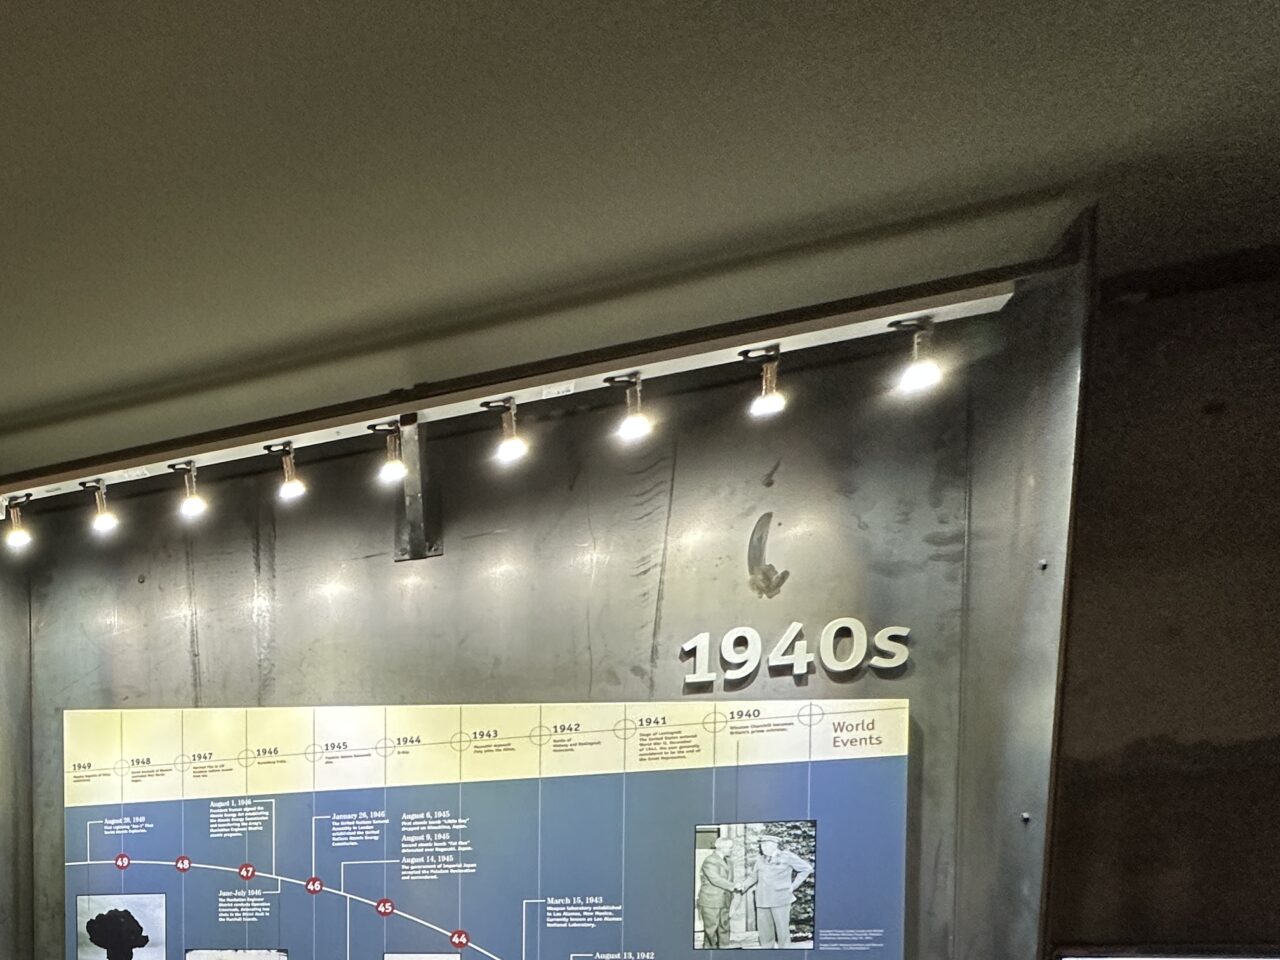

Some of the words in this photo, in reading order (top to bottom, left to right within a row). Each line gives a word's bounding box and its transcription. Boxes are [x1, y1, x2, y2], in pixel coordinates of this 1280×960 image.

[681, 617, 911, 684] 1940s
[730, 709, 760, 719] 1940
[639, 716, 666, 726] 1941
[553, 724, 580, 733] 1942
[832, 720, 875, 733] World
[473, 730, 498, 739] 1943
[396, 736, 421, 745] 1944
[832, 735, 882, 748] Events
[325, 742, 348, 751] 1945
[257, 747, 279, 756] 1946
[192, 753, 213, 761] 1947
[131, 758, 151, 766] 1948
[73, 763, 91, 771] 1949
[434, 810, 450, 818] 1945
[116, 857, 128, 867] 49
[177, 860, 190, 869] 48
[240, 868, 254, 877] 47
[307, 881, 321, 891] 46
[573, 896, 584, 905] 15,
[586, 896, 603, 904] 1943
[378, 903, 392, 913] 45
[452, 934, 467, 944] 44
[594, 952, 621, 960] August
[637, 952, 655, 960] 1942
